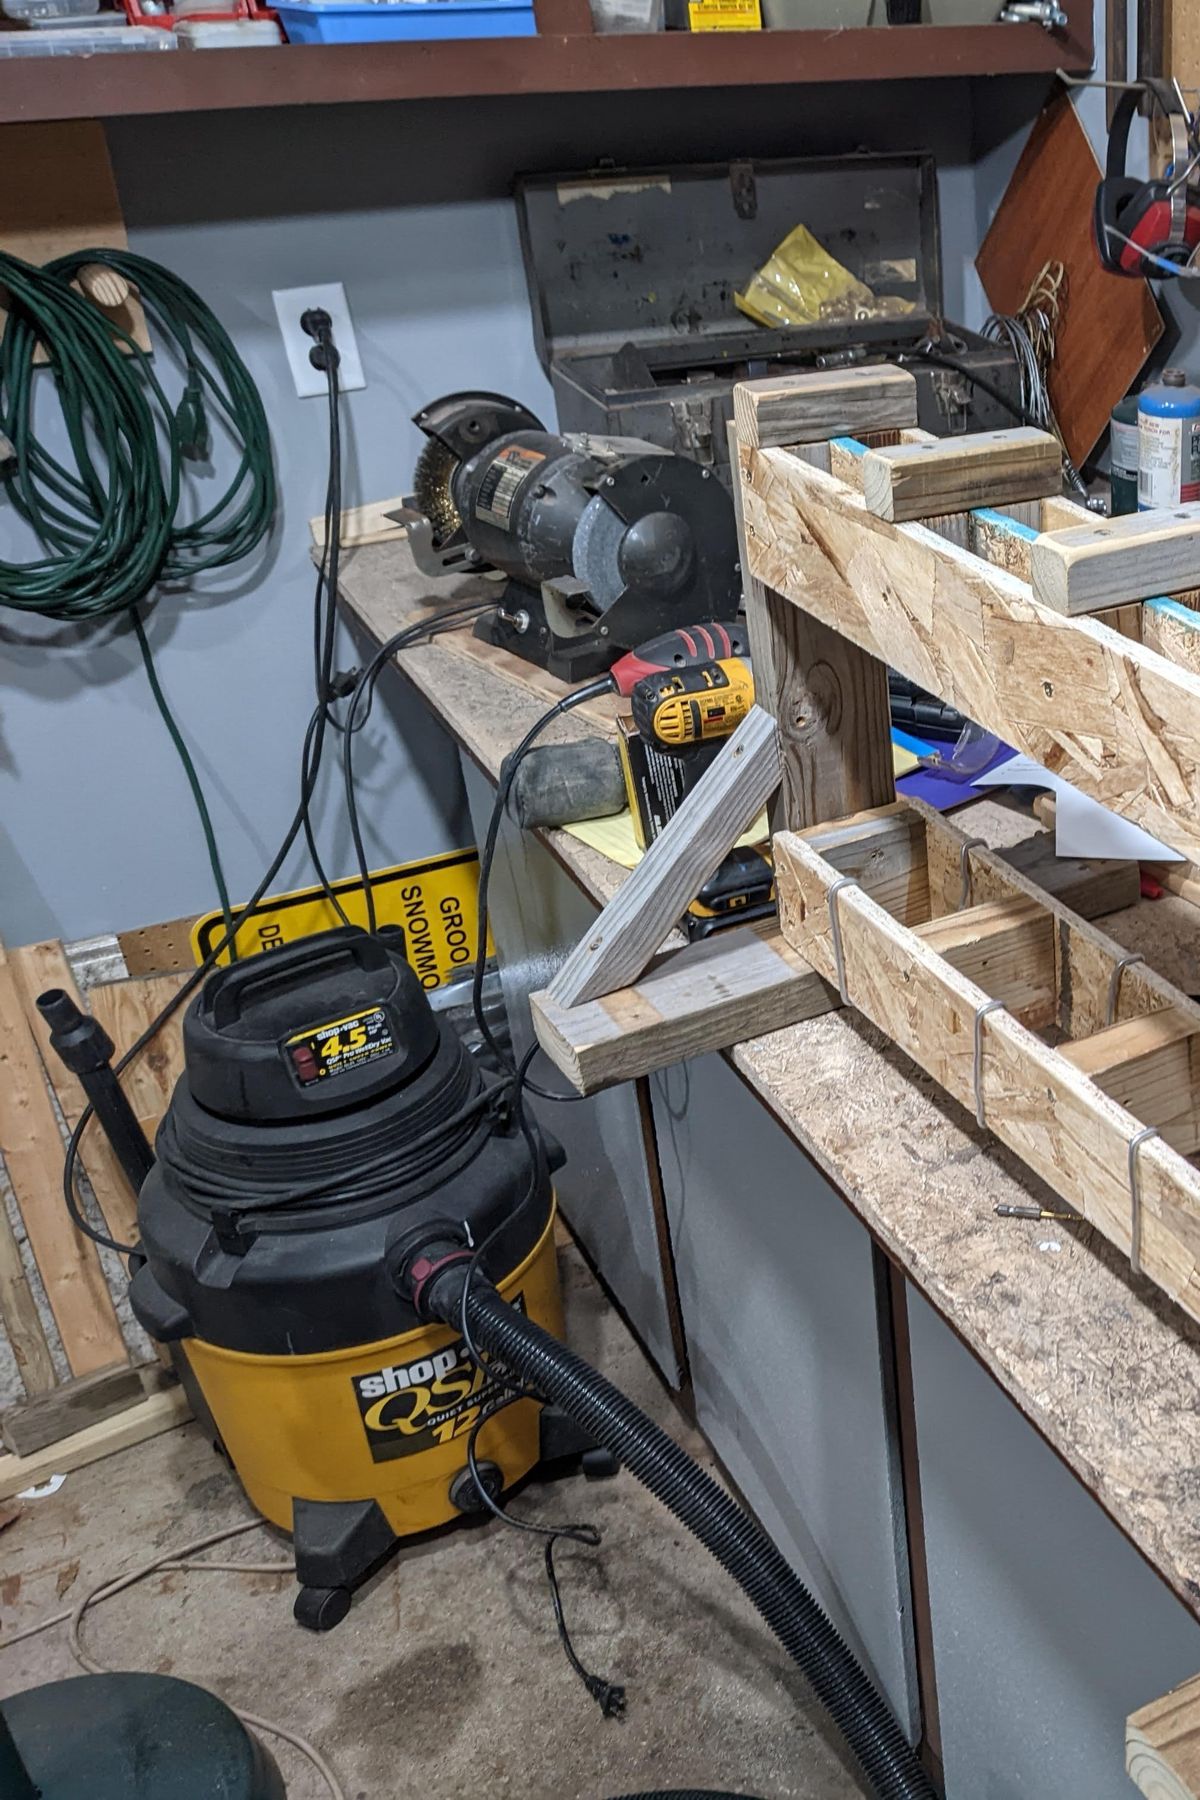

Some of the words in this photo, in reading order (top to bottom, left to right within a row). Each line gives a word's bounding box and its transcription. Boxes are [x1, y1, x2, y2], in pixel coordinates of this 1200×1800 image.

[258, 924, 284, 951] DE
[401, 885, 441, 991] SNOWMO
[440, 896, 470, 966] GROO
[321, 1026, 367, 1057] 4.5
[343, 1050, 355, 1060] Pro
[380, 1036, 393, 1045] Vac
[427, 1404, 463, 1426] QUIET
[432, 1405, 481, 1444] 12
